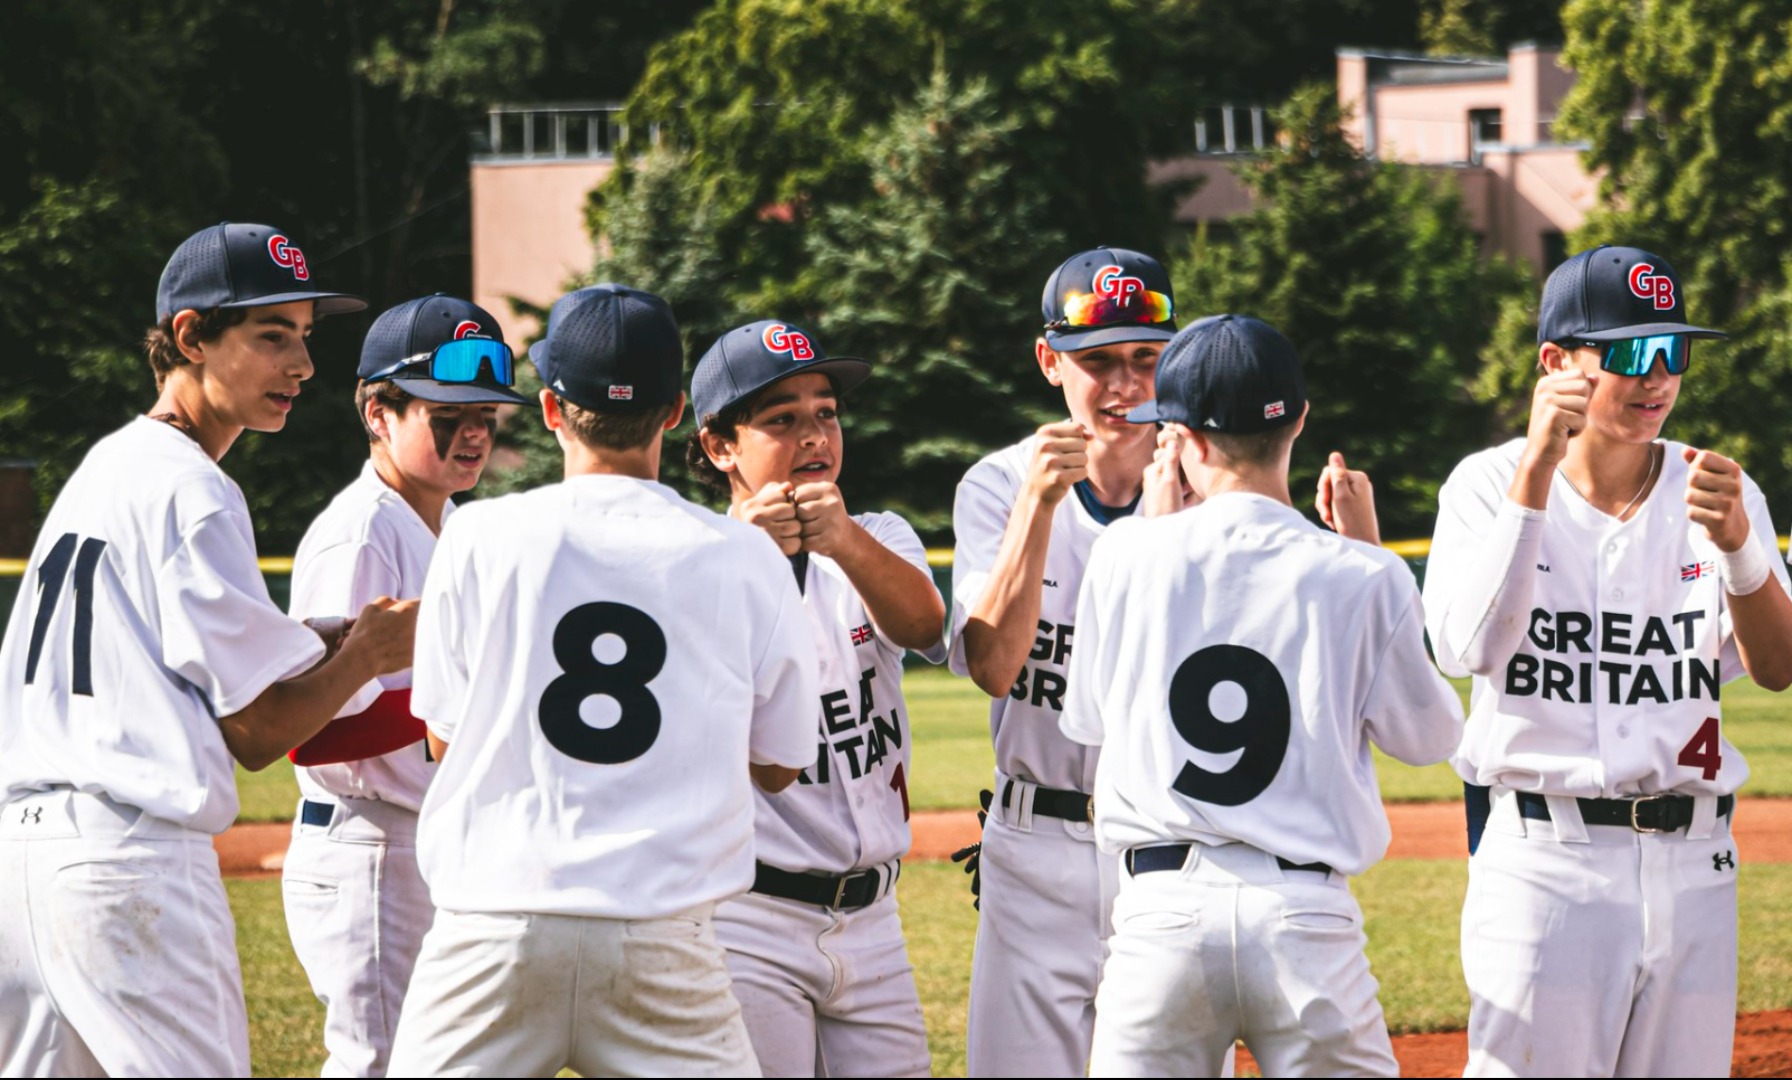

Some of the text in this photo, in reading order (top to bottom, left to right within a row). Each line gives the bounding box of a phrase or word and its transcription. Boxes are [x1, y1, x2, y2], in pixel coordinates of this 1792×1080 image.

[267, 234, 310, 281] GB
[1629, 263, 1675, 310] GB
[762, 323, 815, 361] GB
[25, 533, 107, 696] 11
[1527, 607, 1705, 656] GREAT
[538, 600, 667, 765] 8
[819, 666, 877, 736] EAT
[1505, 652, 1721, 705] BRITAIN
[1168, 643, 1291, 807] 9
[1677, 716, 1722, 781] 4
[889, 761, 910, 823] 1
